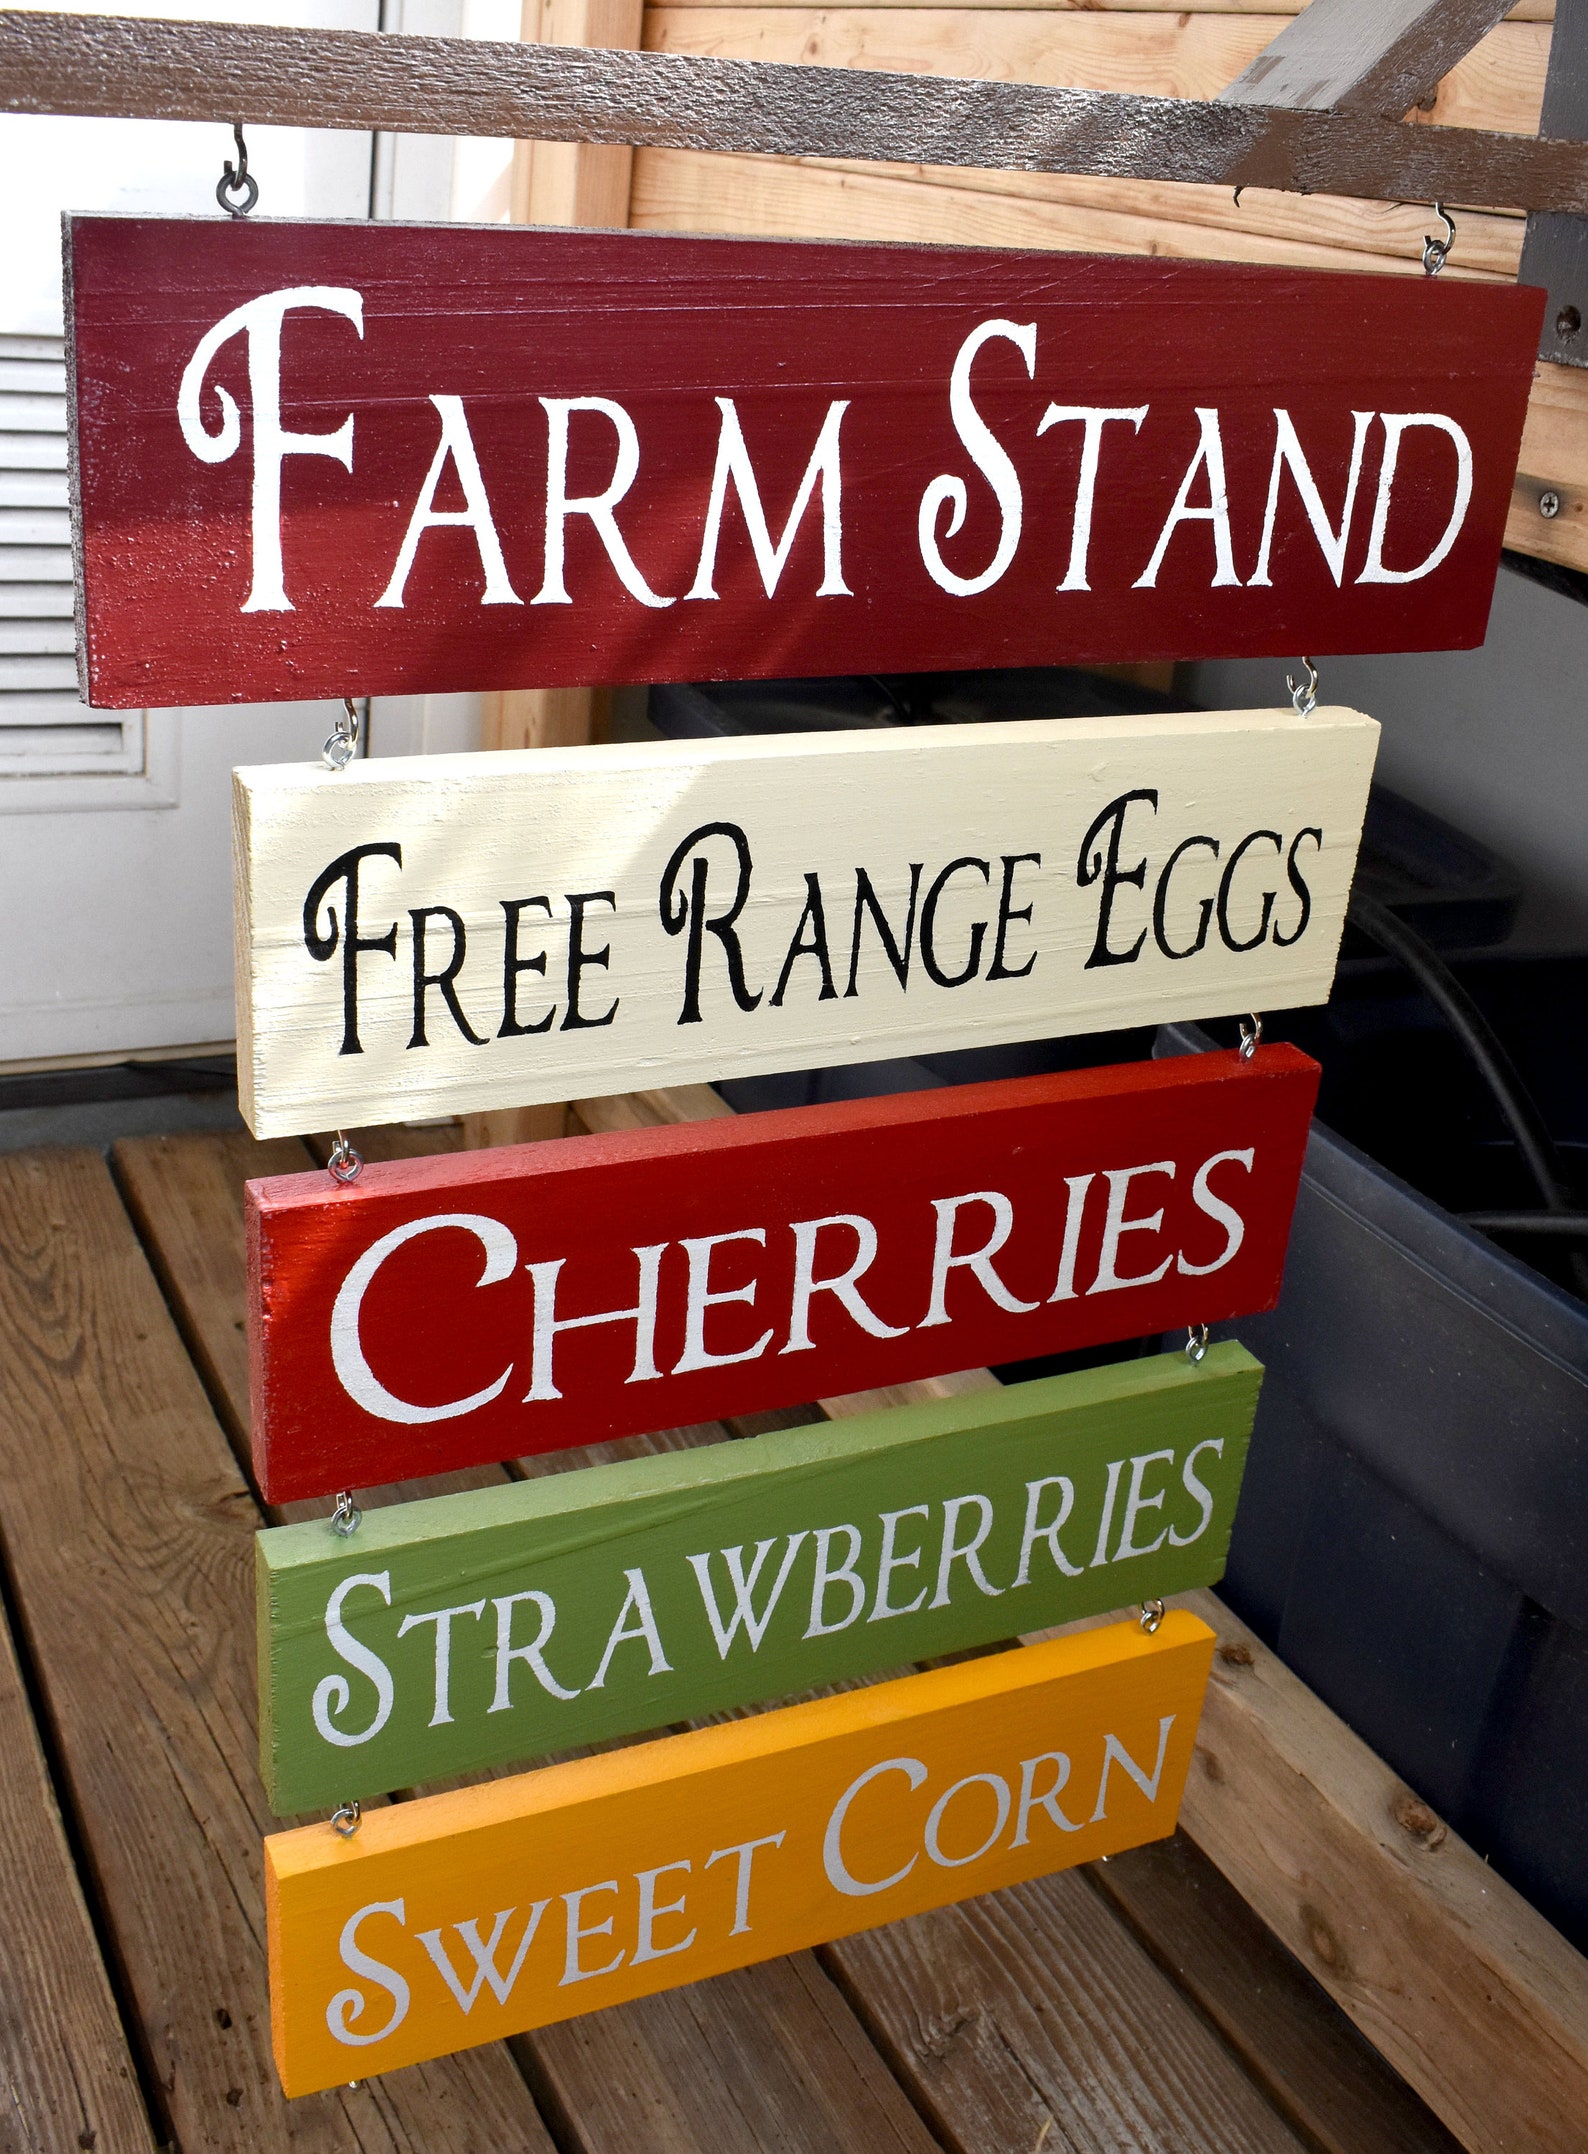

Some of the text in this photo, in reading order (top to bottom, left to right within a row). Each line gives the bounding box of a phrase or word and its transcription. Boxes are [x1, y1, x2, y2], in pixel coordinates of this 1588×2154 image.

[177, 285, 1474, 613] FARM STAND
[303, 788, 1322, 1055] FREE RANGE EGGS
[330, 1147, 1255, 1425] CHERRIES
[312, 1438, 1224, 1747] STRAWBERRIES
[325, 1714, 1177, 2046] SWEET CORN
